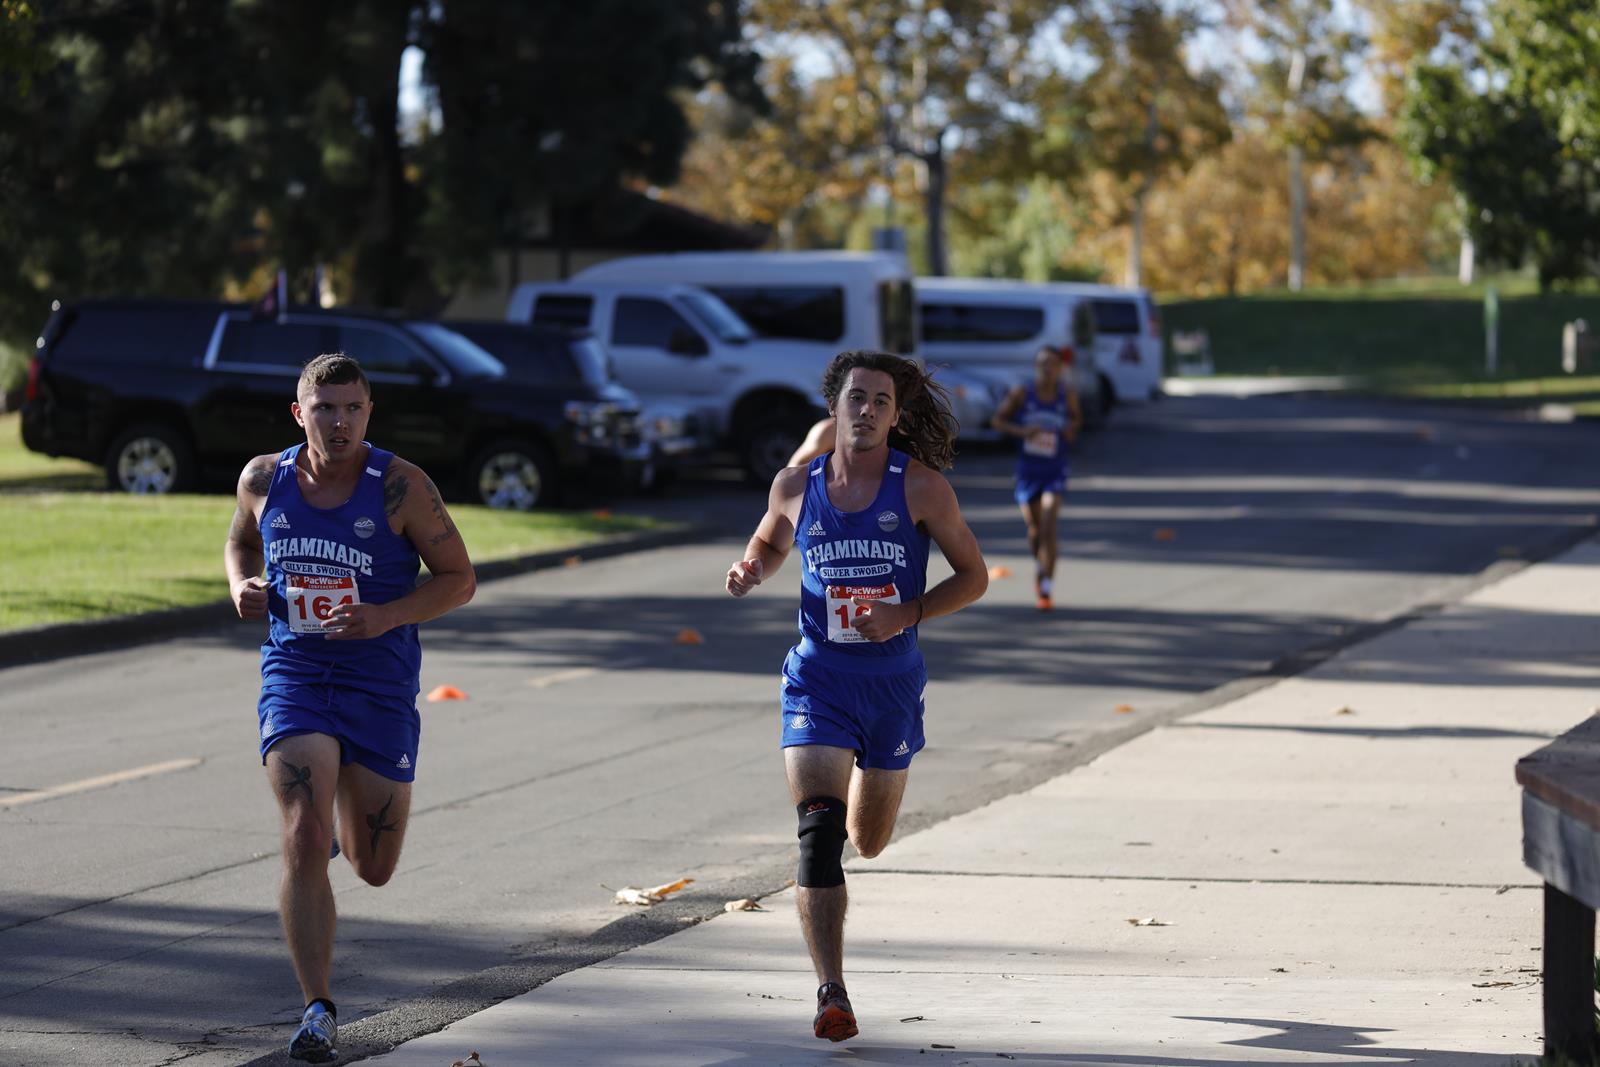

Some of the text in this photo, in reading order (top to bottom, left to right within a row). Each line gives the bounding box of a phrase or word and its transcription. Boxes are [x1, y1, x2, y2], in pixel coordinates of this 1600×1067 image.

[270, 537, 373, 577] CHAMINADE
[806, 539, 907, 573] CHAMINADE
[285, 562, 351, 577] SILVER SWORDS
[823, 564, 889, 577] SILVER SWORDS
[304, 576, 343, 585] PacWest
[845, 586, 887, 595] PacWest
